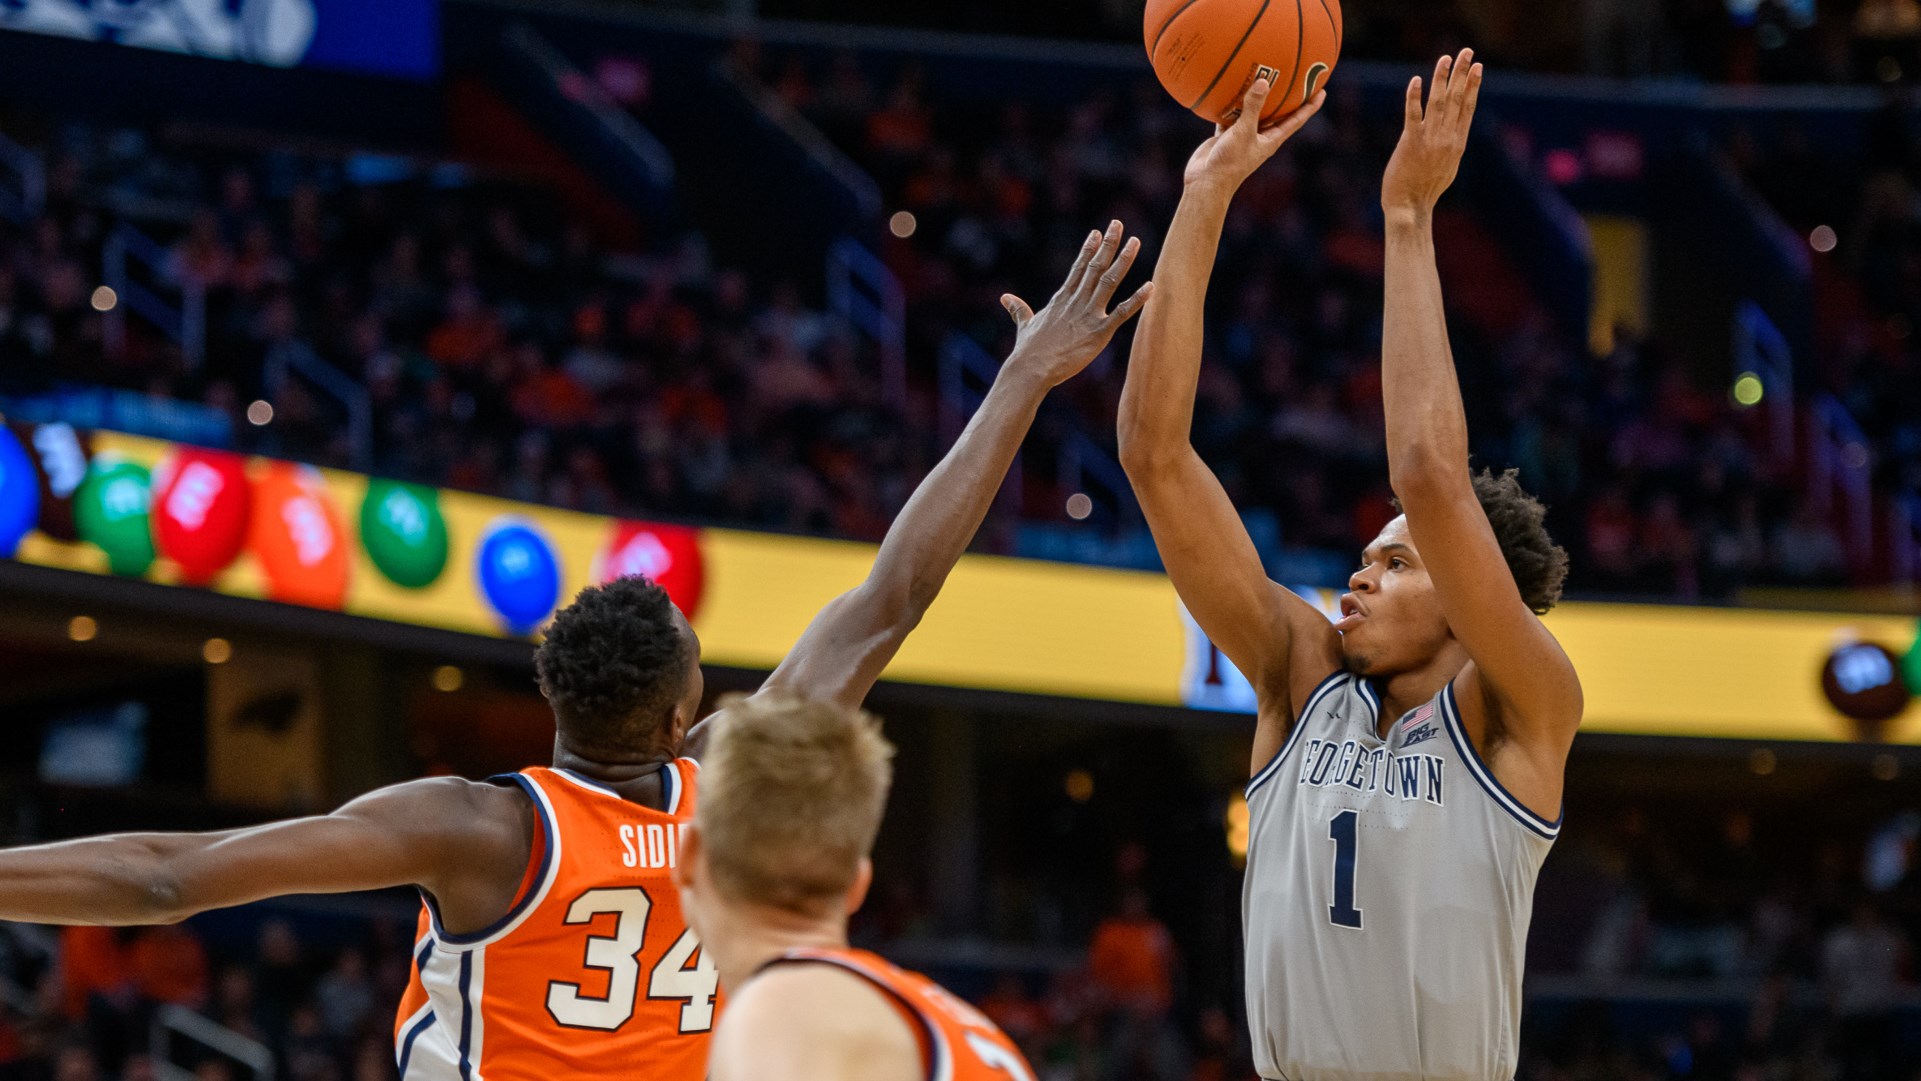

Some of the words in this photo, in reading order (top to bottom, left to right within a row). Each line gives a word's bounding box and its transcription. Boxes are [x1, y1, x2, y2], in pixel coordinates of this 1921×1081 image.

[1299, 739, 1446, 807] EOGETOWN
[1407, 723, 1430, 740] BIG
[1328, 809, 1363, 930] 1
[545, 886, 720, 1034] 34
